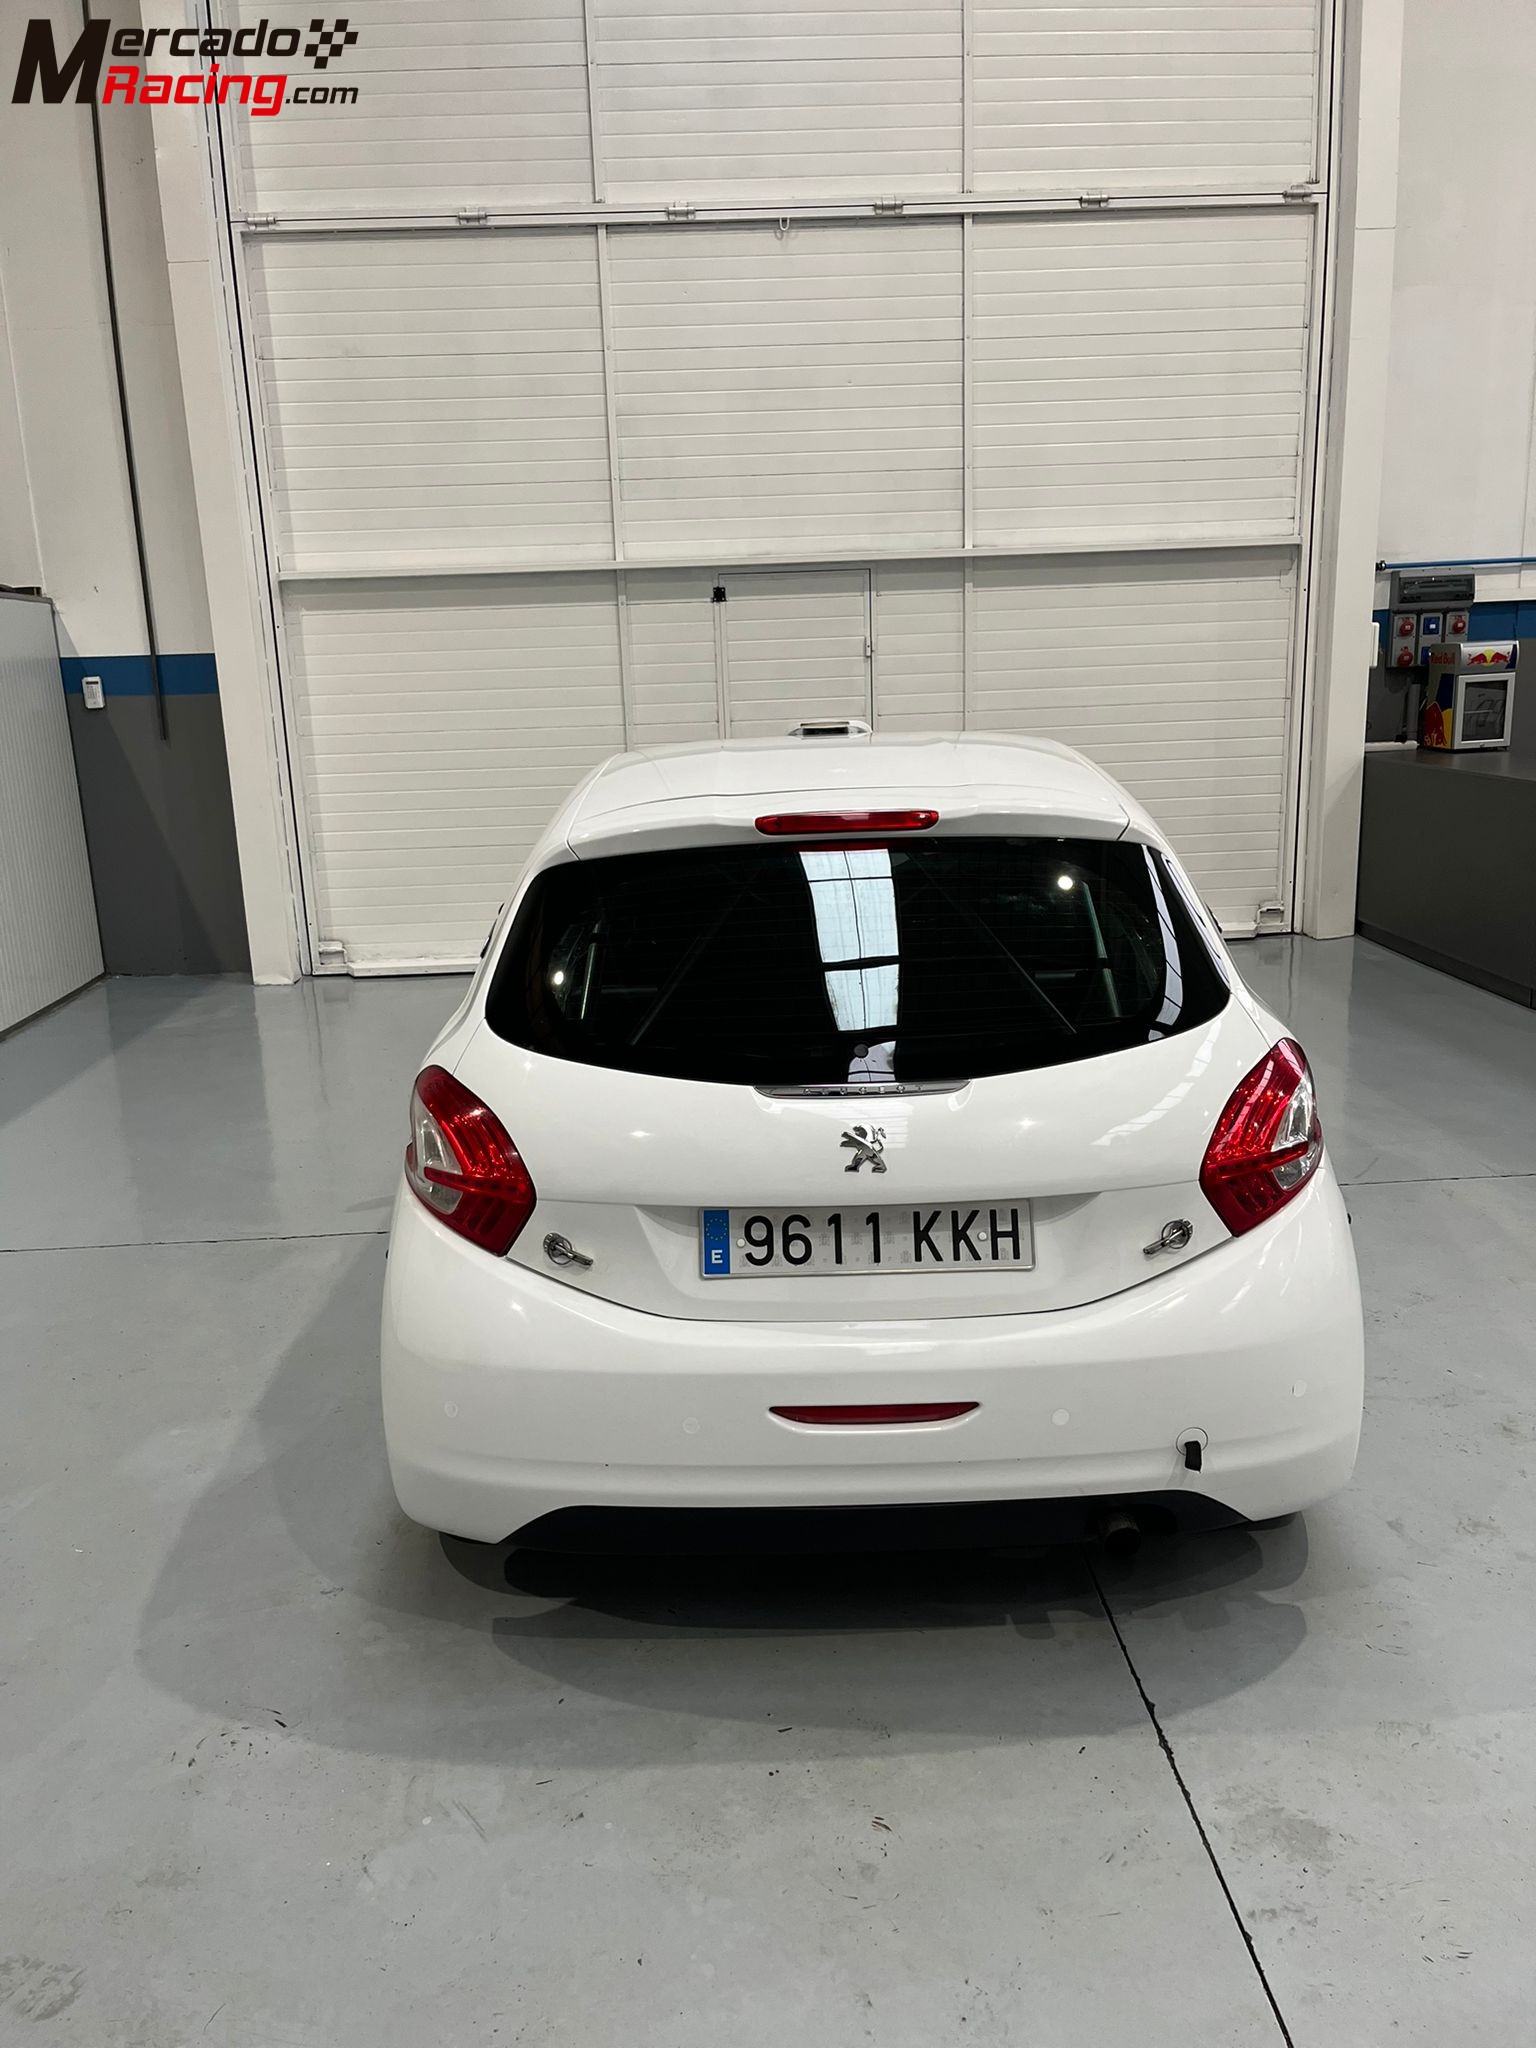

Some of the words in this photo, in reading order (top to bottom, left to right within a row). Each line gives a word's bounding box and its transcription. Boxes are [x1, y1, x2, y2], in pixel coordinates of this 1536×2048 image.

[743, 1211, 882, 1266] 9611
[912, 1208, 1021, 1262] KKH
[711, 1249, 724, 1264] E
